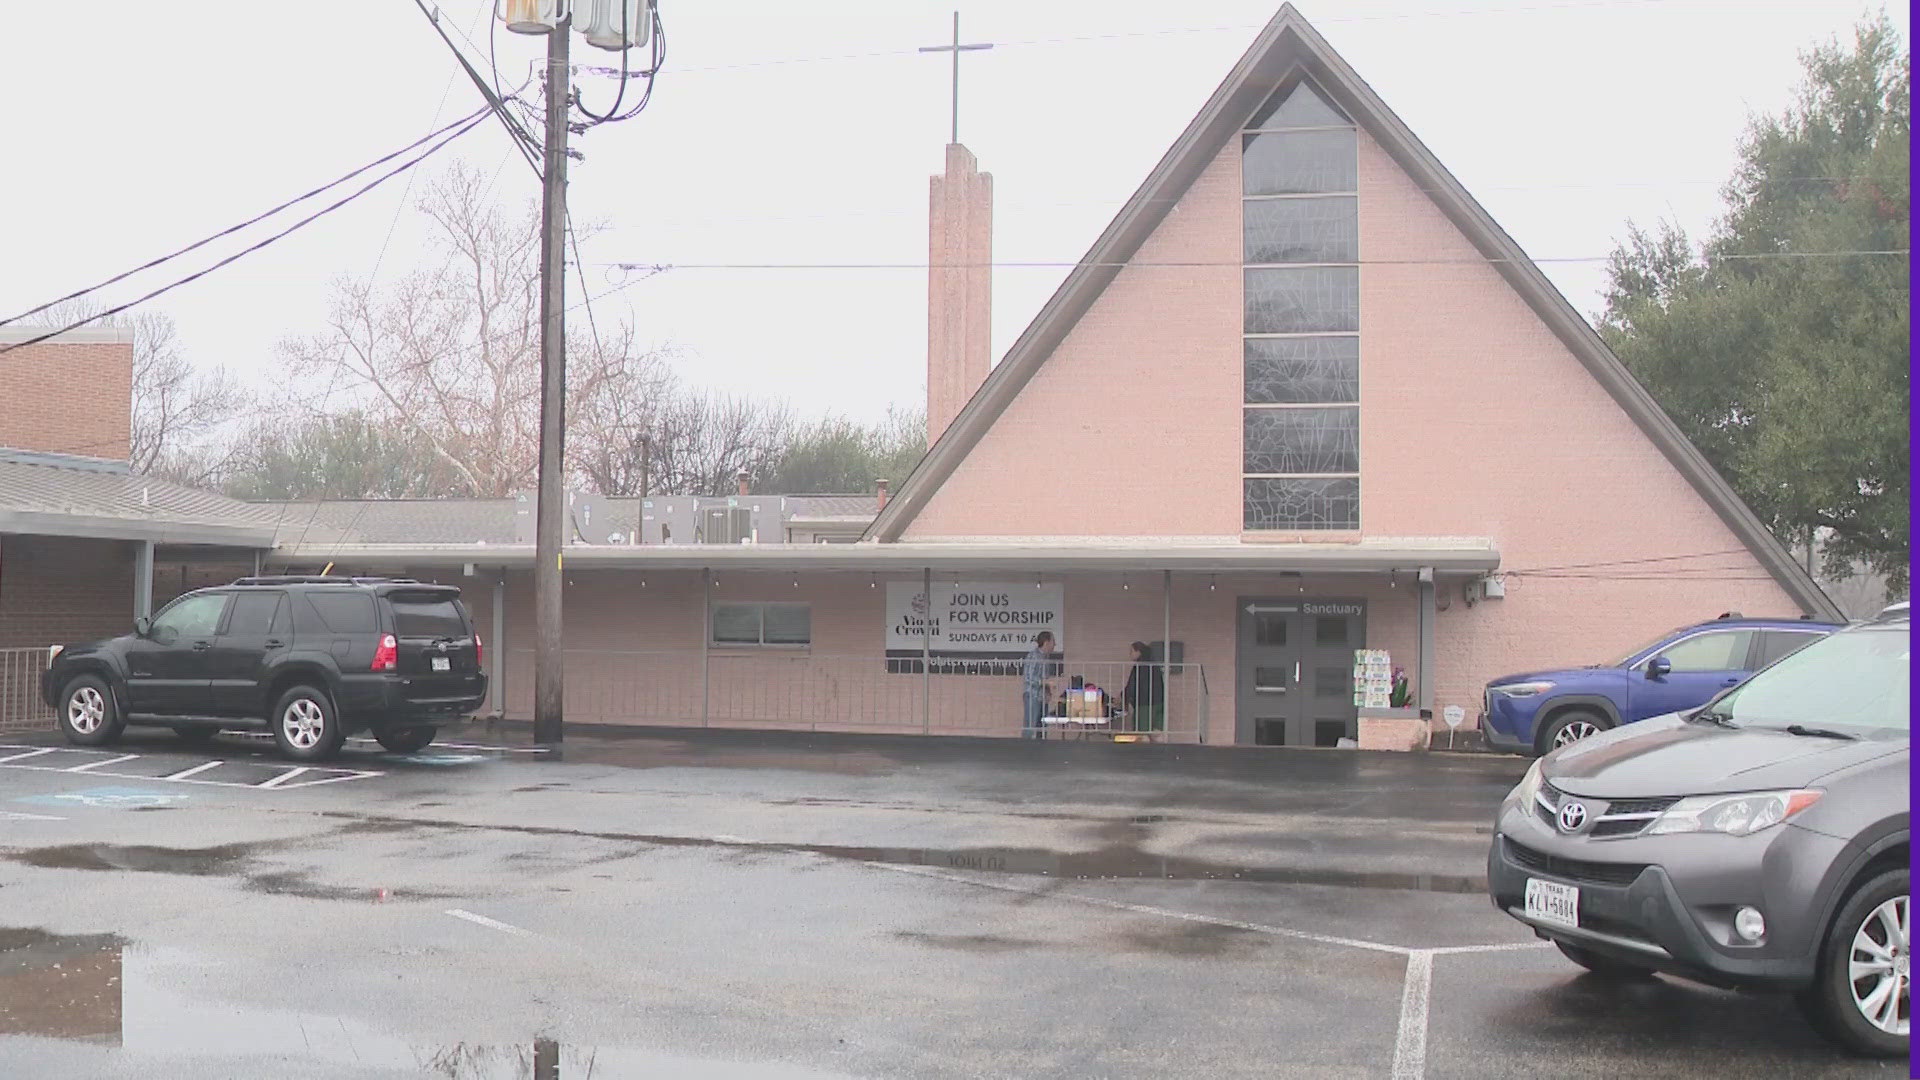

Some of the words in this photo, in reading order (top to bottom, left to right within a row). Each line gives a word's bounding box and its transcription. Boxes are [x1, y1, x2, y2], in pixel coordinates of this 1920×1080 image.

[949, 593, 985, 606] JOIN
[990, 593, 1009, 606] US
[1303, 602, 1363, 616] Sanctuary
[903, 615, 939, 626] Vioet
[949, 611, 979, 623] FOR
[983, 611, 1054, 624] WORSHIP
[948, 633, 997, 643] SUNDAYS
[999, 633, 1013, 643] AT
[1016, 633, 1027, 644] 10
[1029, 634, 1038, 644] A
